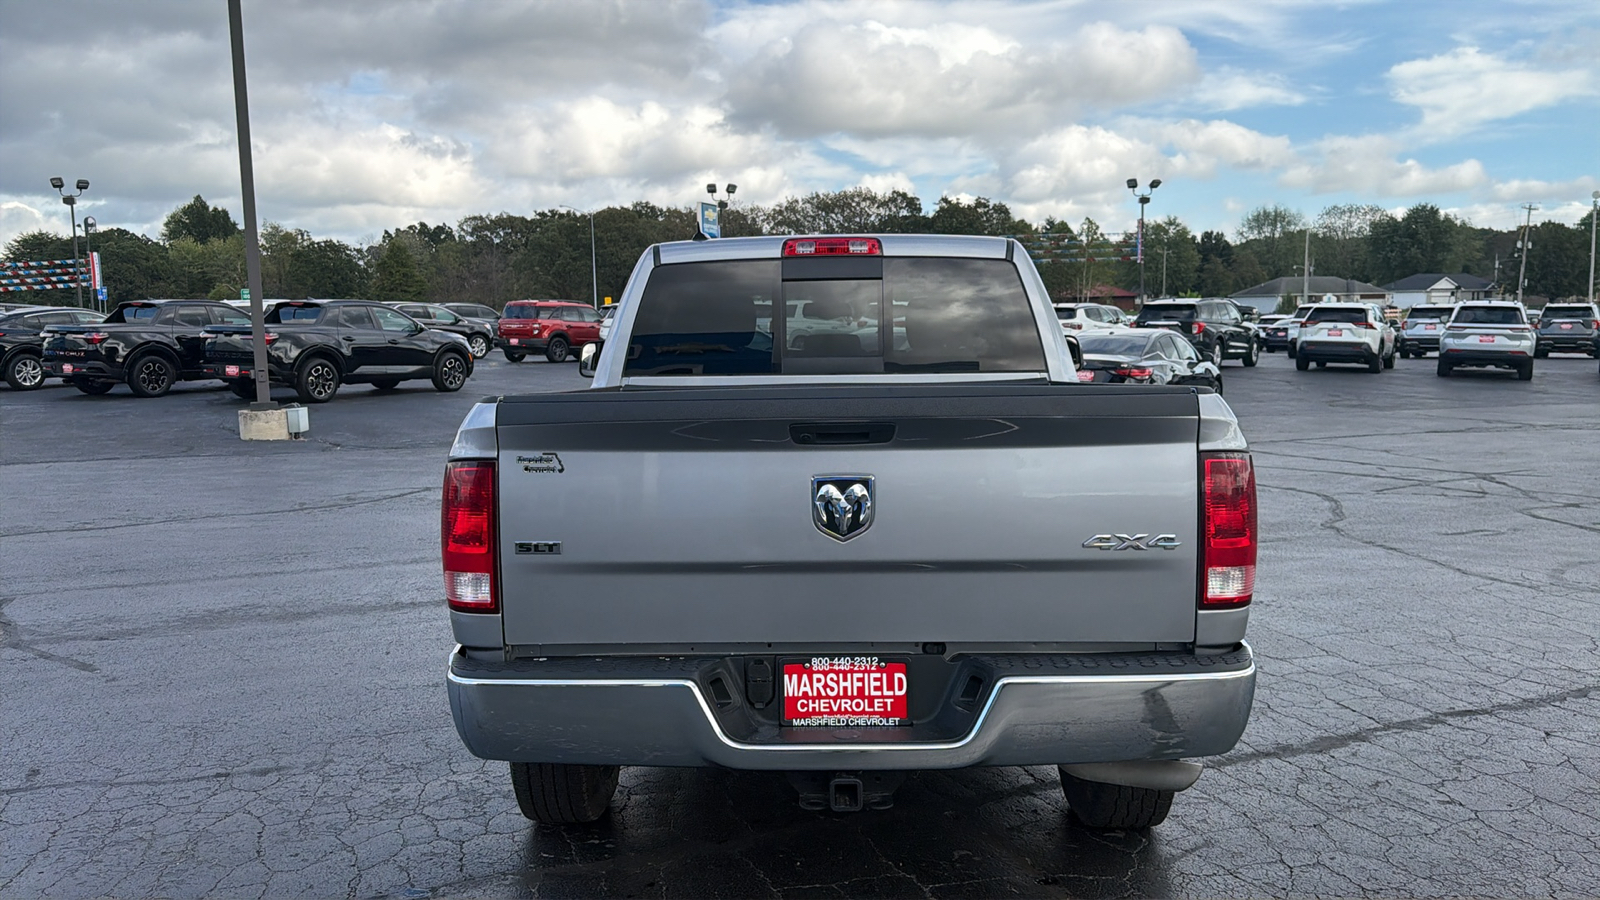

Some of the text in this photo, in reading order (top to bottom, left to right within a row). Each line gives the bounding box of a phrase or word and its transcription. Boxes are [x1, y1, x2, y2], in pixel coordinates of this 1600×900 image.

[518, 542, 558, 553] SLT
[1082, 533, 1182, 551] 4X4
[811, 656, 879, 666] 800-440-2312
[784, 672, 908, 697] MARSHFIELD
[796, 698, 895, 713] CHEVROLET
[792, 717, 901, 726] MARSHFIELD CHEVROLET
